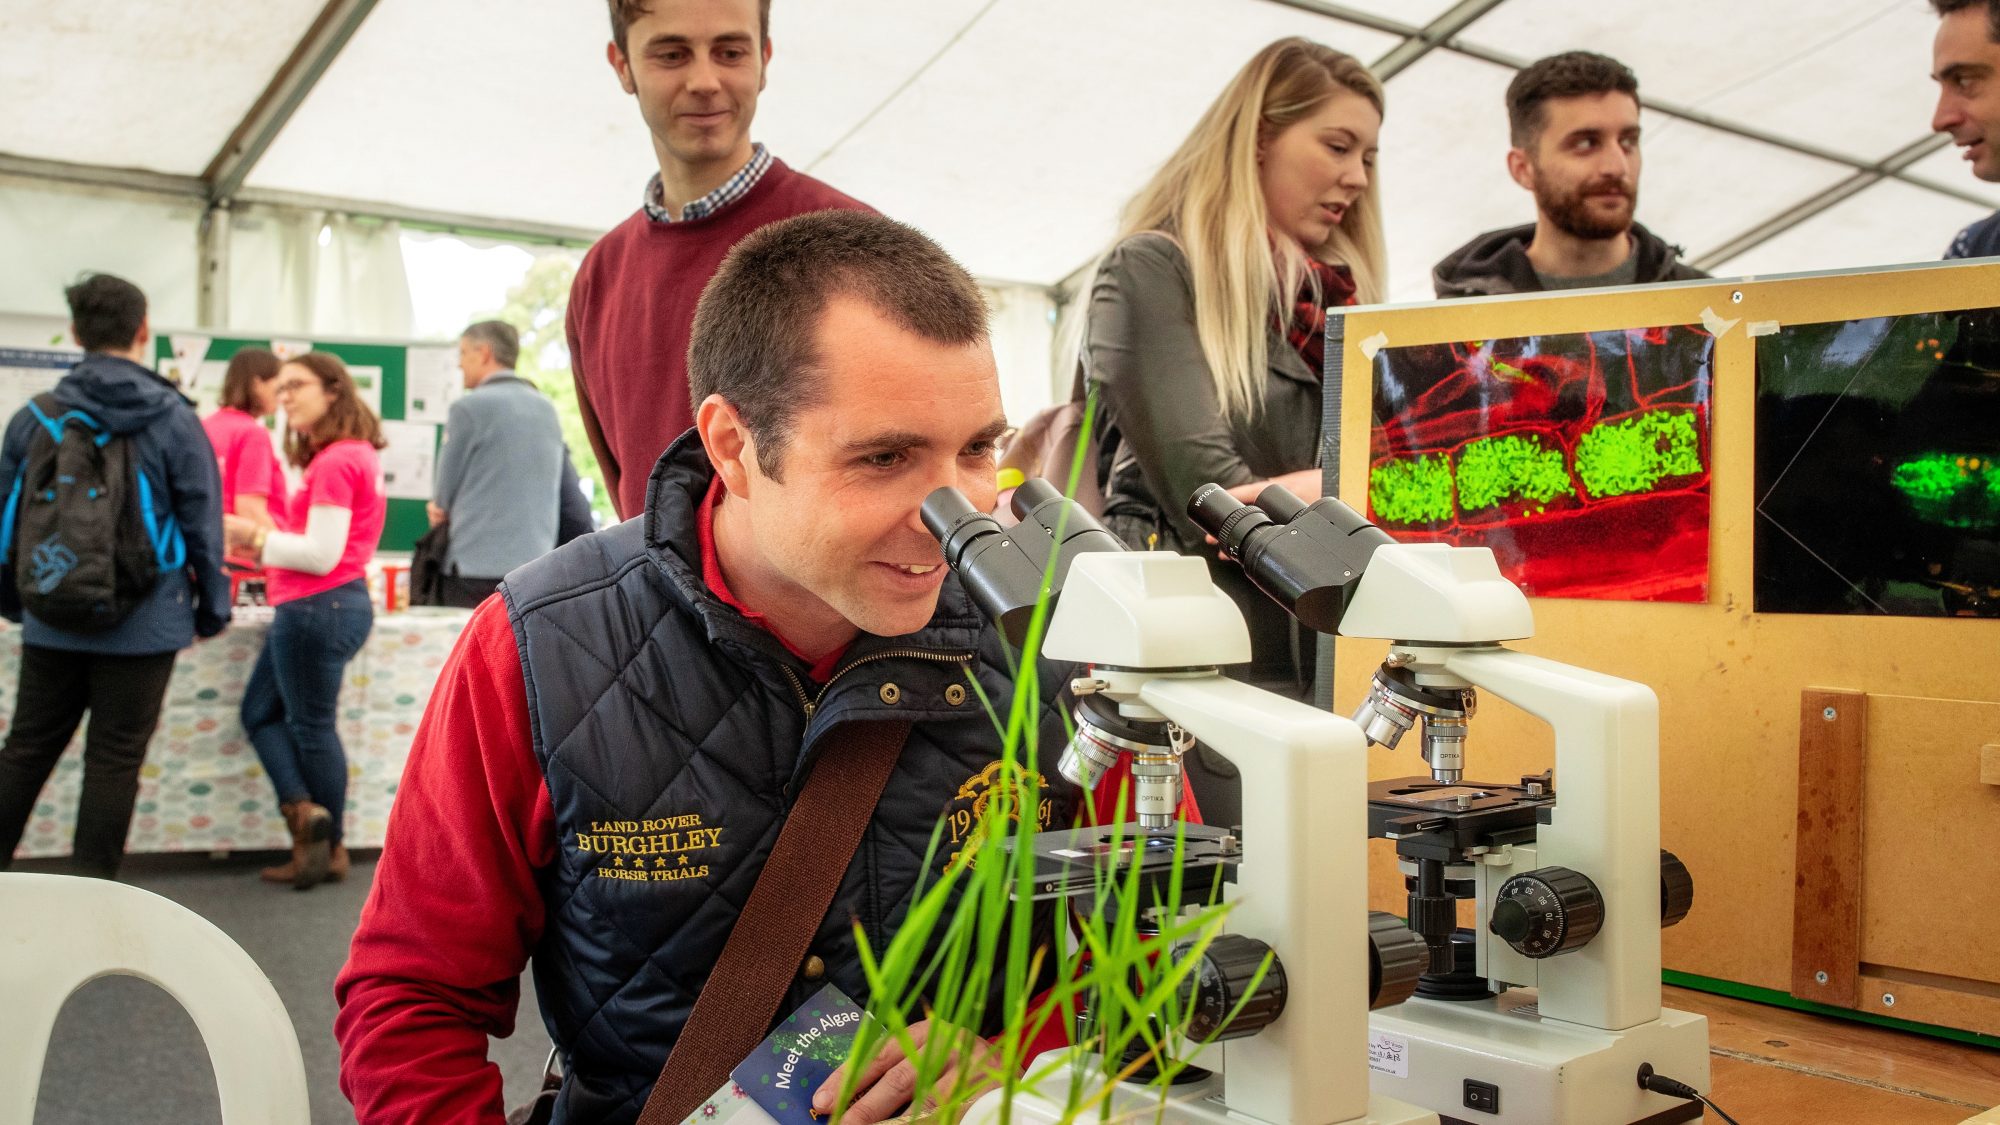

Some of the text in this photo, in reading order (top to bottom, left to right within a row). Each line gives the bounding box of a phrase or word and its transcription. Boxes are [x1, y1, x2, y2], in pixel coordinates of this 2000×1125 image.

[591, 814, 702, 833] LAND ROVER
[948, 809, 971, 843] 19
[576, 828, 723, 854] BURGHLEY
[598, 865, 709, 881] HORSE TRIALS
[1525, 887, 1534, 895] 50
[1538, 896, 1548, 906] 60
[1545, 912, 1554, 922] 70
[1542, 929, 1552, 939] 80
[1205, 996, 1215, 1007] 70
[775, 1011, 860, 1089] Meet the Algae
